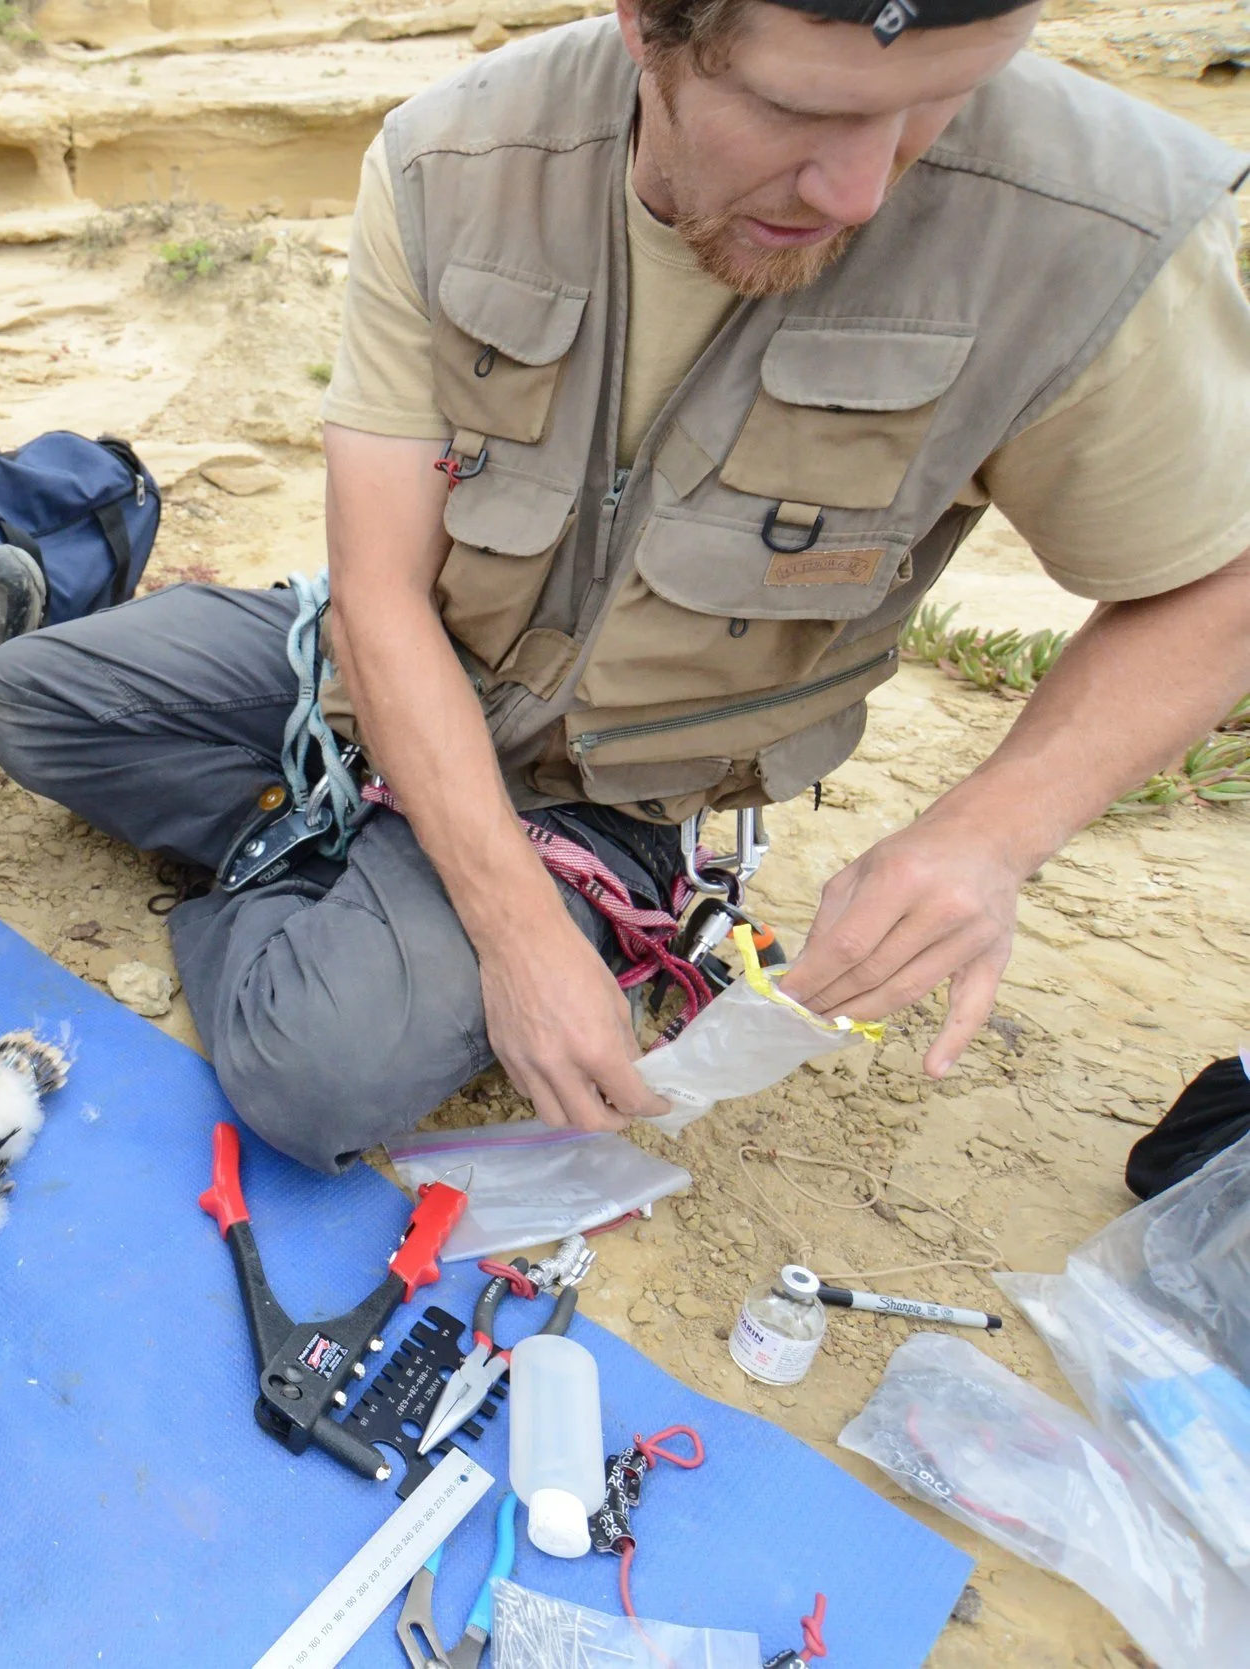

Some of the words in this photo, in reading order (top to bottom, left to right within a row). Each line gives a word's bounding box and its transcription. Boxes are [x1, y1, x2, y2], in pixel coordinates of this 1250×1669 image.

[484, 1283, 499, 1303] TASK
[876, 1296, 922, 1315] Sharpie
[397, 1382, 405, 1390] 3
[424, 1377, 441, 1402] AVINET
[388, 1396, 395, 1404] 2
[295, 1650, 309, 1665] 150
[321, 1622, 333, 1637] 170
[333, 1609, 346, 1623] 180
[344, 1595, 357, 1609] 190
[356, 1582, 369, 1597] 200
[368, 1569, 380, 1583] 210
[379, 1556, 392, 1571] 220
[390, 1543, 403, 1559] 230
[401, 1531, 414, 1546] 240
[412, 1519, 425, 1534] 250
[423, 1507, 436, 1522] 260
[433, 1495, 446, 1510] 270
[463, 1462, 477, 1475] 300
